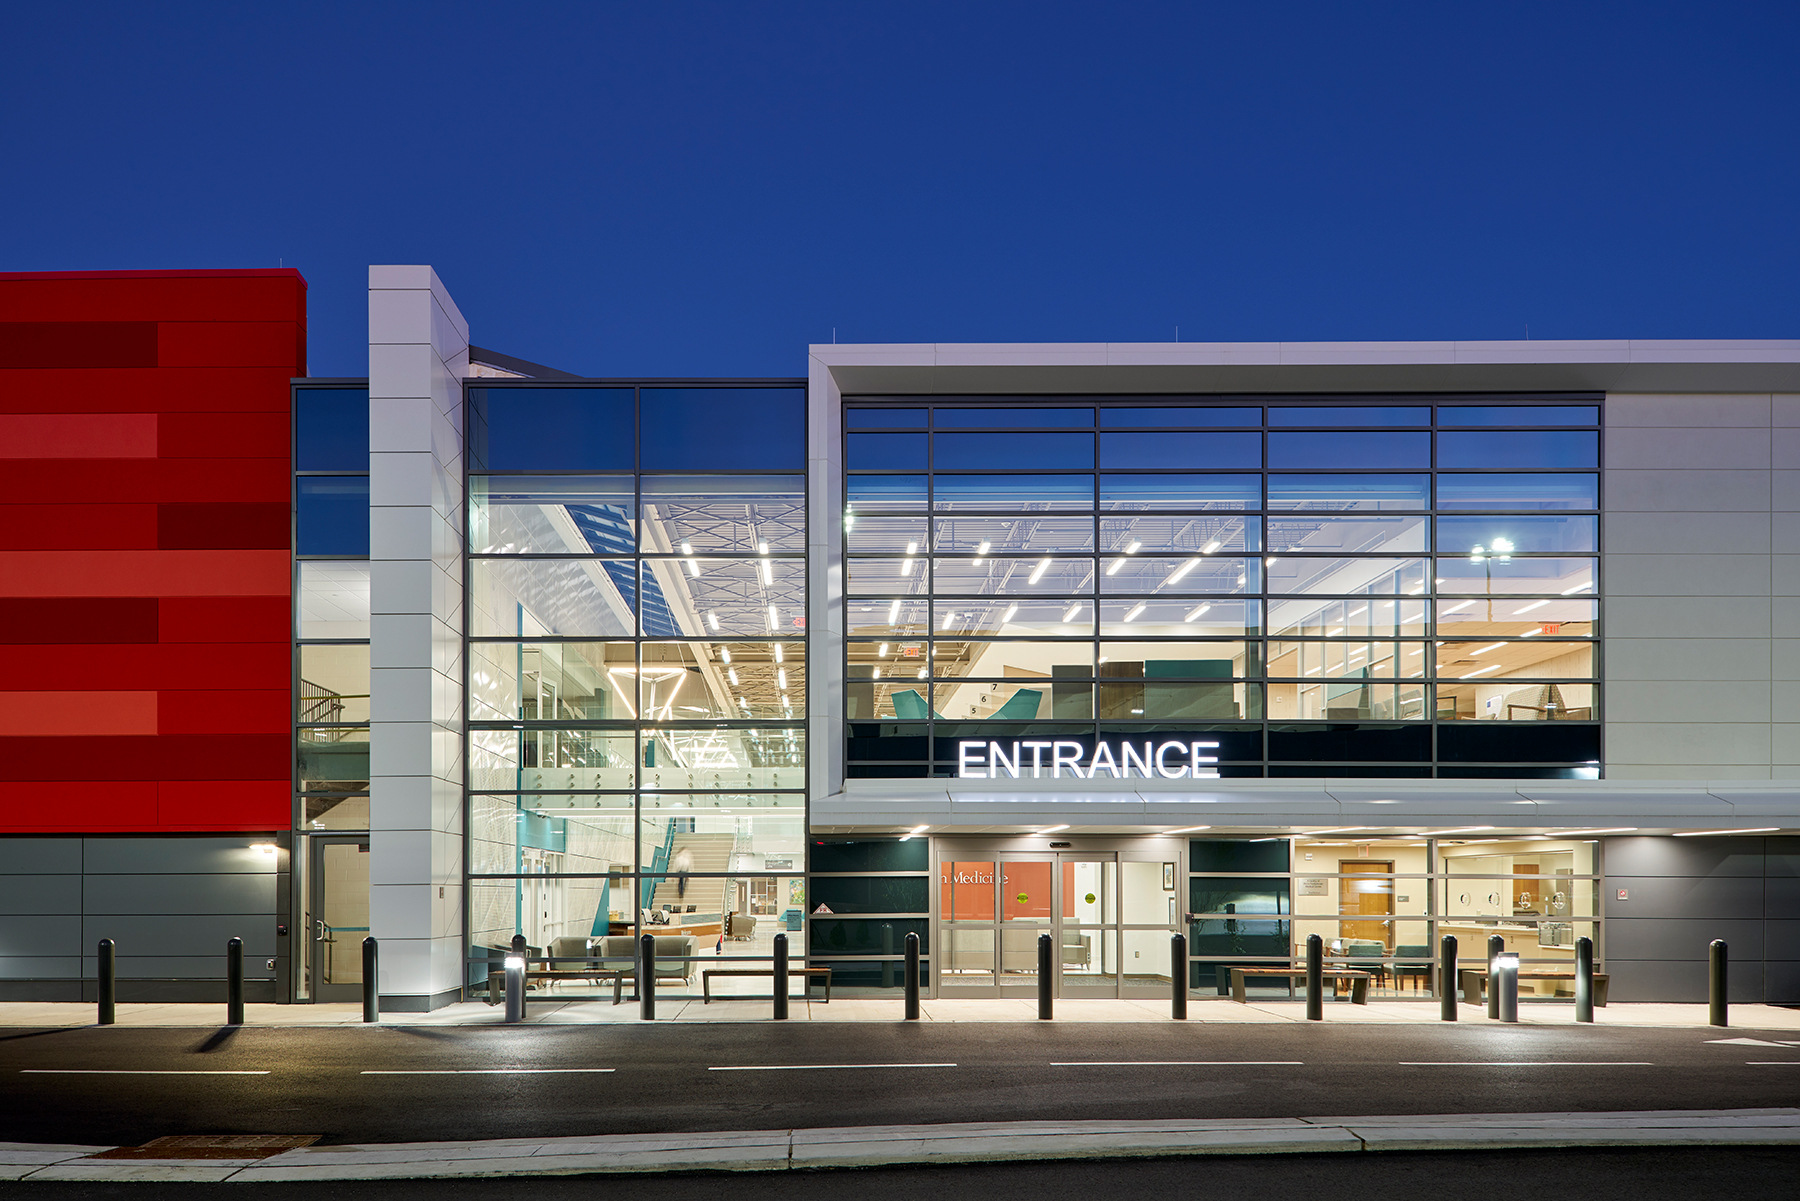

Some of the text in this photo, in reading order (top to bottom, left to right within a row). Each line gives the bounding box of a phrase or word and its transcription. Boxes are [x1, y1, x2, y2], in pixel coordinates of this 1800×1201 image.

[1545, 624, 1560, 635] EXIT
[906, 648, 919, 656] EXIT
[992, 683, 998, 691] 7
[981, 695, 987, 703] 6
[971, 707, 977, 715] 5
[958, 741, 1221, 779] ENTRANCE
